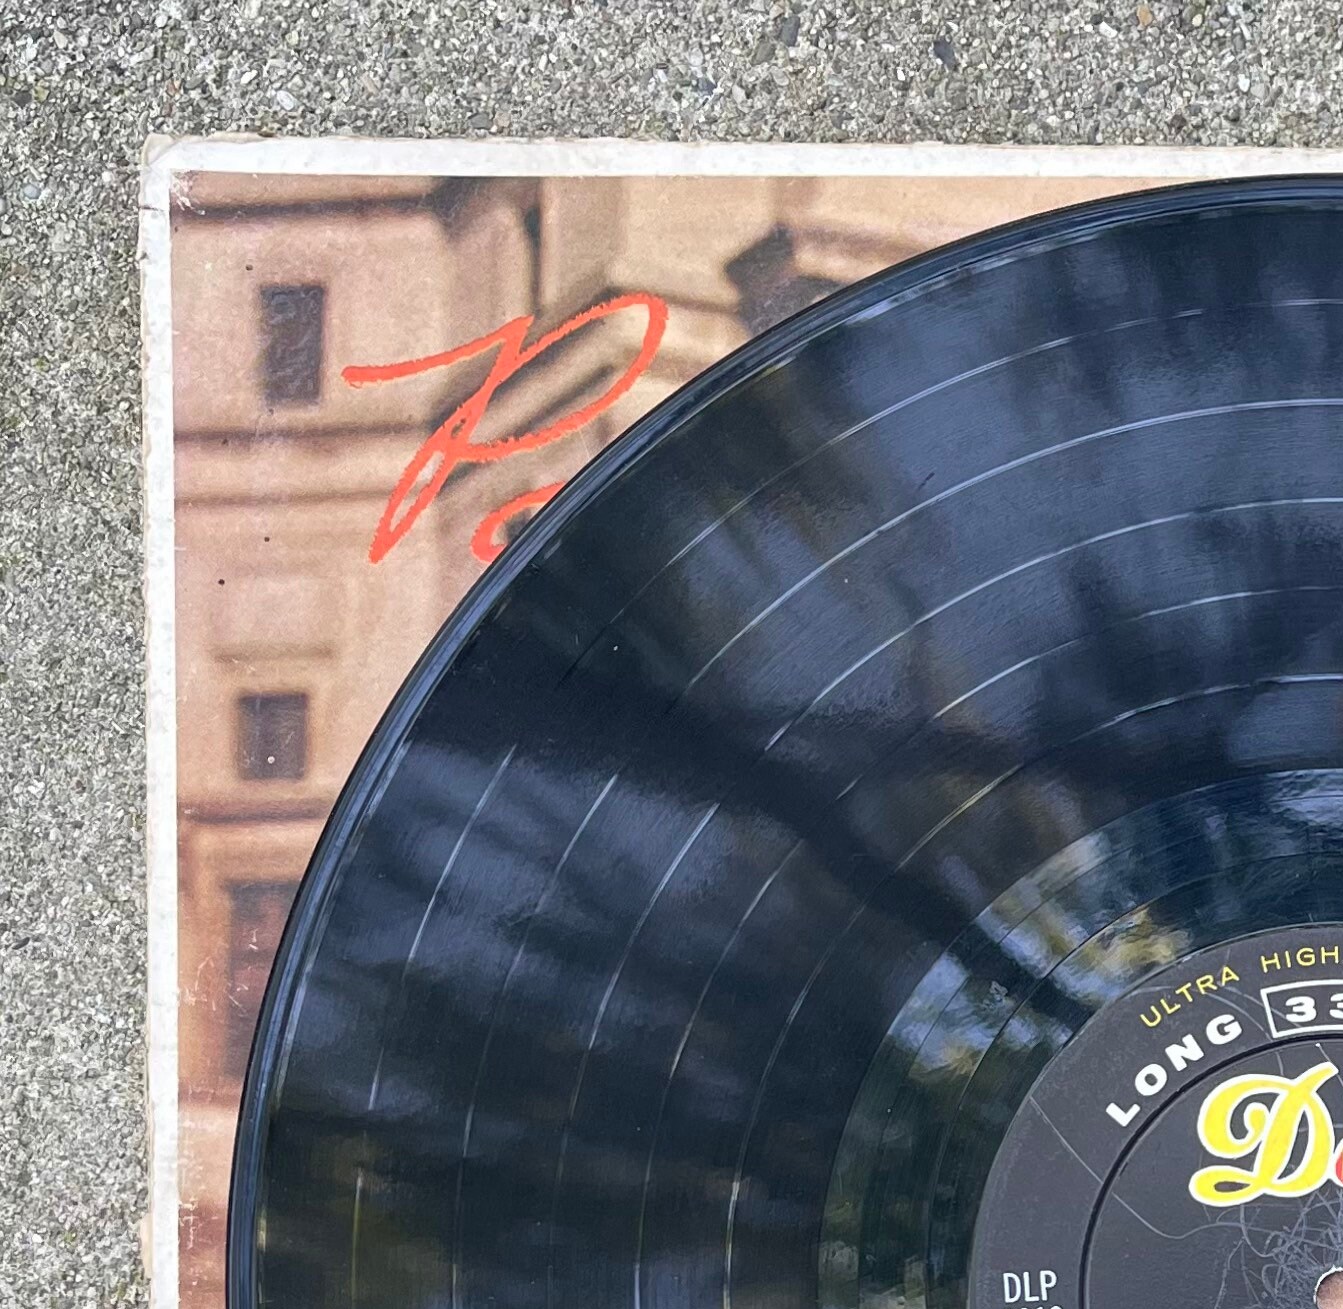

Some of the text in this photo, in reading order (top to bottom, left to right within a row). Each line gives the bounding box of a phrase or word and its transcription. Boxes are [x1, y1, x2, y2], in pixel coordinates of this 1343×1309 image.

[1140, 965, 1240, 1028] ULTRA
[1260, 945, 1340, 973] HIGH
[1105, 1013, 1243, 1128] LONG
[1002, 1270, 1058, 1303] DLP
